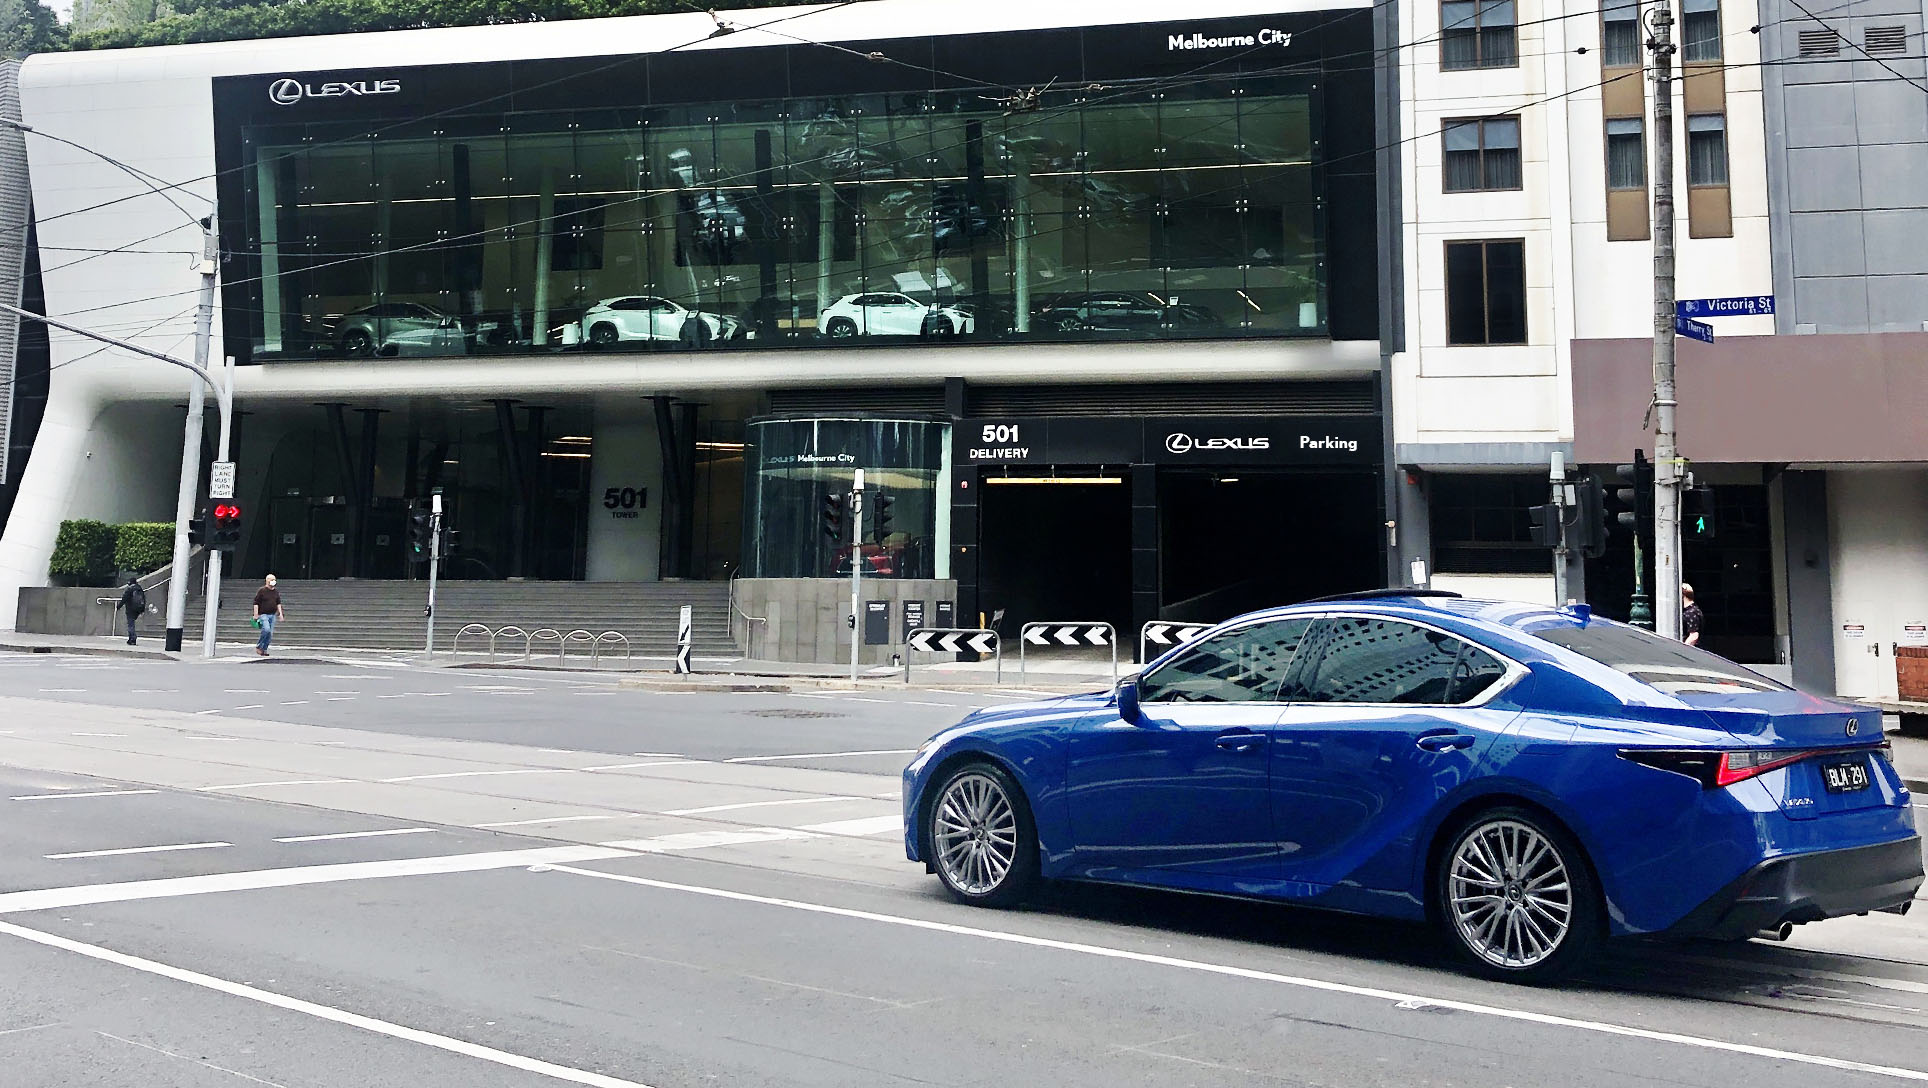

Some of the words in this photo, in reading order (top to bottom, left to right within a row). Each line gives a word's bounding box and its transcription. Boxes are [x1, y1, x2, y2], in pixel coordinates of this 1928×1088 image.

[1168, 33, 1255, 51] Melbourne
[1258, 28, 1292, 47] City
[304, 79, 401, 97] LEXUS
[1707, 298, 1755, 311] Victoria
[1758, 297, 1772, 309] St
[1687, 320, 1706, 337] Therry
[982, 424, 1019, 443] 501
[1195, 437, 1270, 449] LEXUS
[1300, 435, 1358, 452] Parking
[797, 454, 837, 463] Melbourne
[838, 453, 855, 463] City
[969, 448, 1029, 459] DELIVERY
[604, 487, 648, 509] 501
[612, 511, 639, 519] TOWER
[1850, 765, 1868, 784] 291
